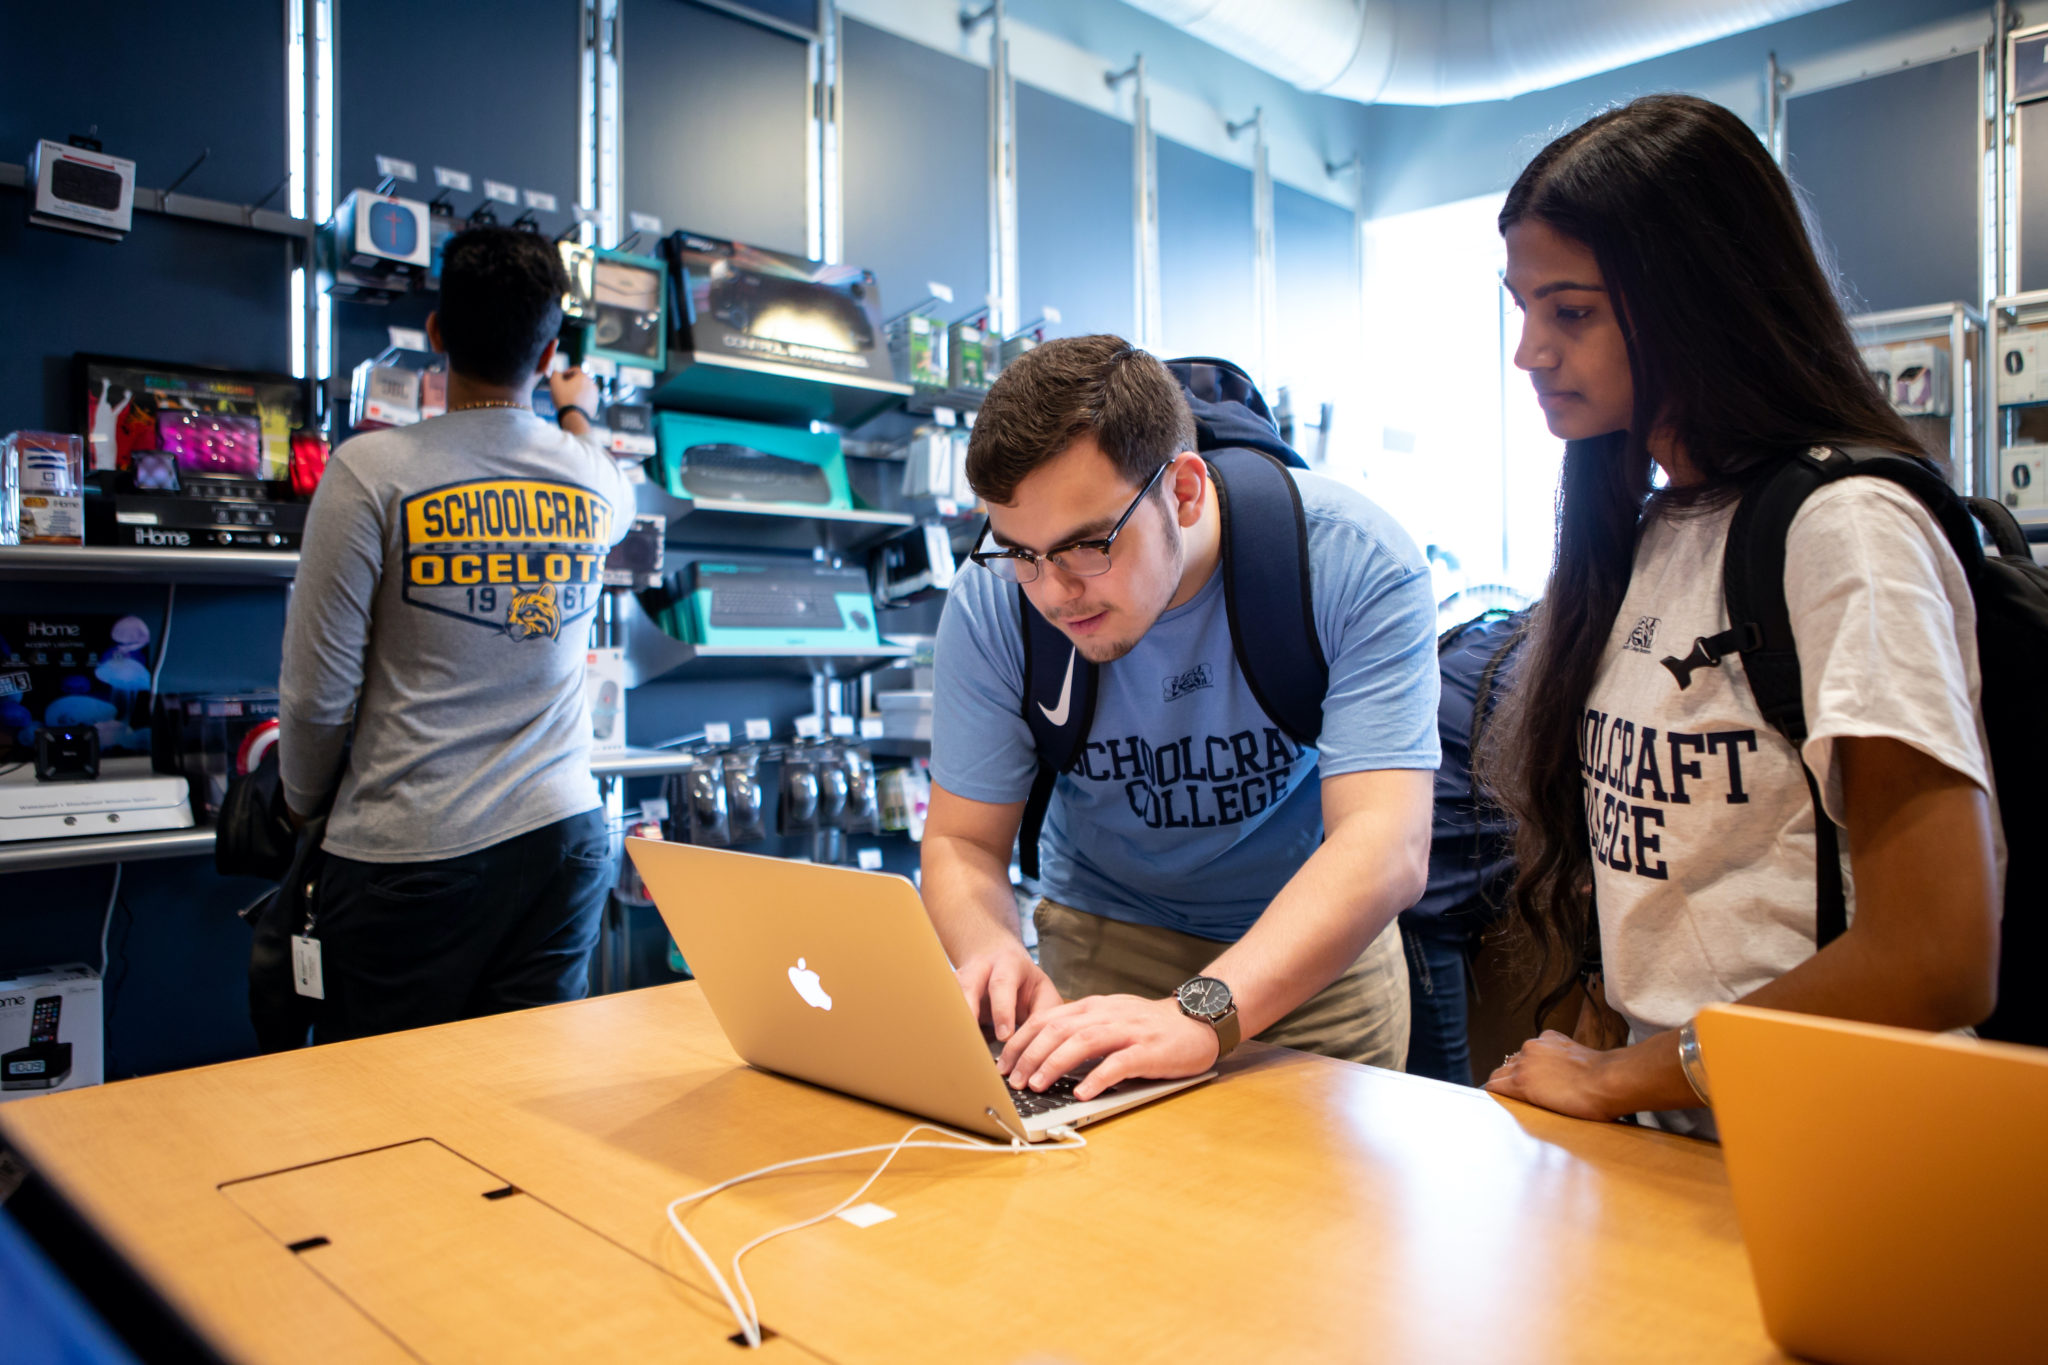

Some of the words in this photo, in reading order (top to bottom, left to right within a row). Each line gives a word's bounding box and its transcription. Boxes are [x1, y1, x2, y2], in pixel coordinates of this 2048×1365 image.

[423, 488, 608, 538] SCHOOLCRAFT
[134, 527, 191, 546] iHome
[465, 587, 497, 614] 19
[563, 586, 587, 611] 61
[28, 621, 81, 636] iHome
[1579, 708, 1758, 805] OLCRAFT
[1125, 766, 1291, 829] COLLEGE
